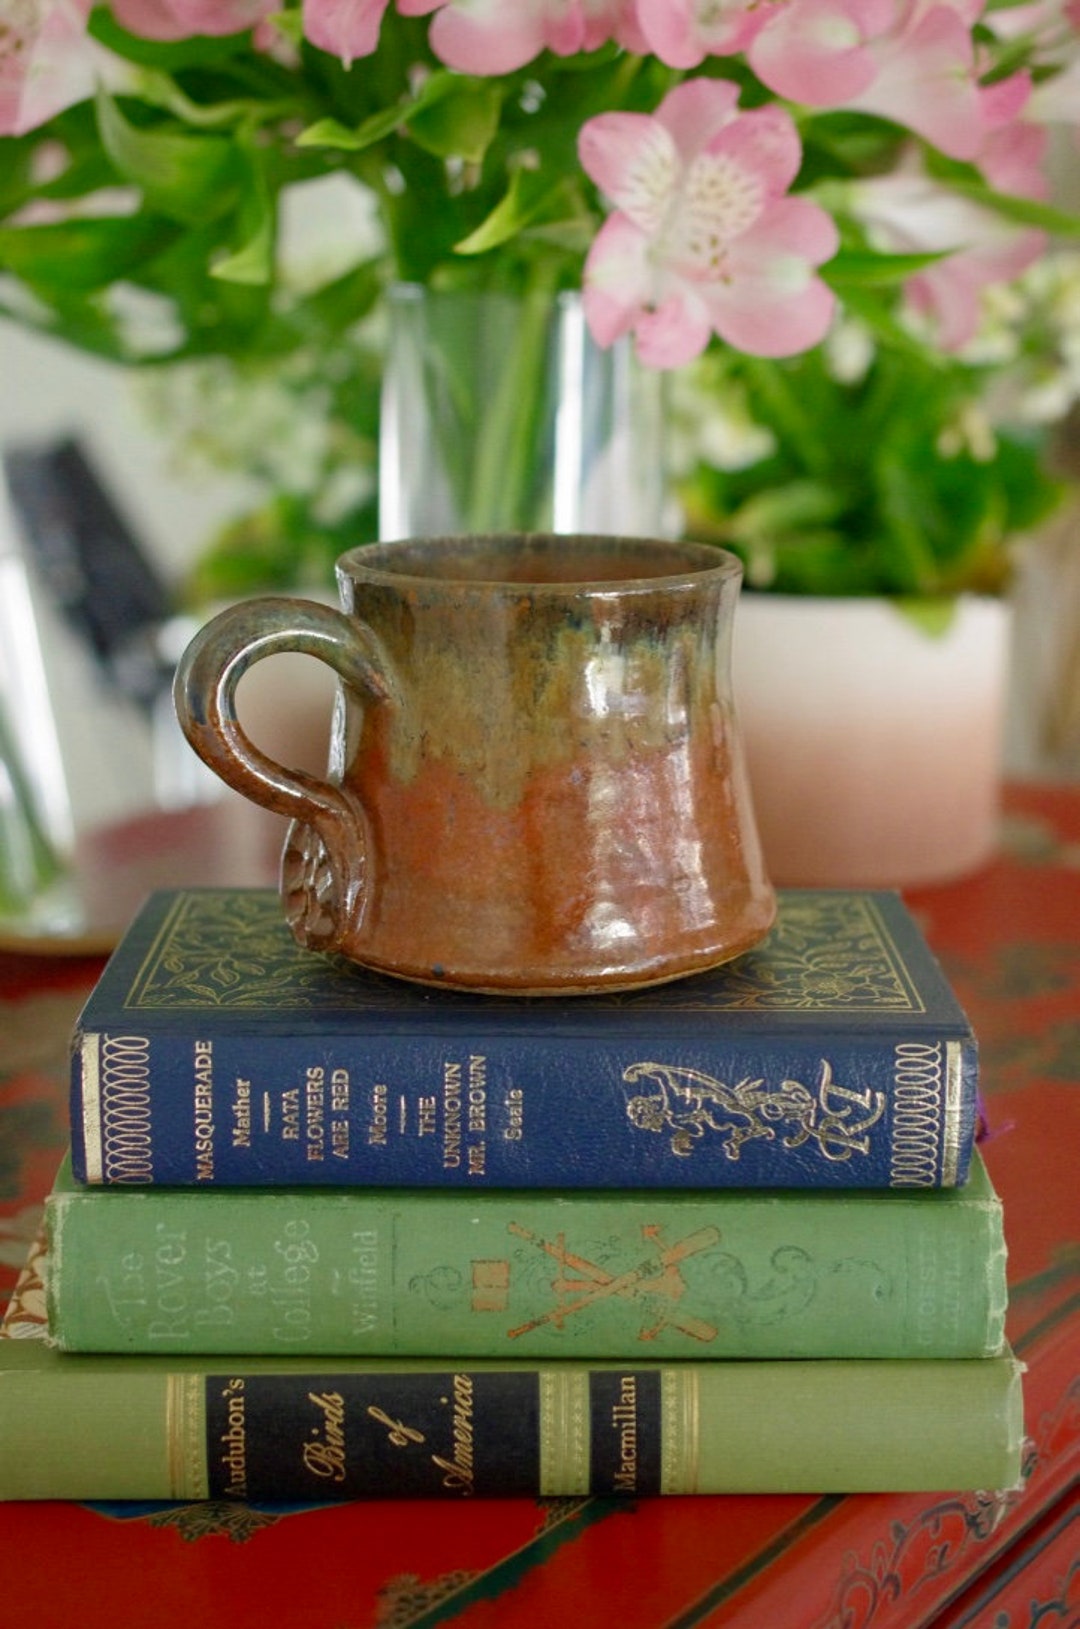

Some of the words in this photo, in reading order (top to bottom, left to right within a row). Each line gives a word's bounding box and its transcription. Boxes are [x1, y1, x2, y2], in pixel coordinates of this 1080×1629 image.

[194, 1040, 215, 1181] MASQUERADE
[232, 1078, 251, 1148] Mather
[282, 1088, 299, 1140] RATA
[307, 1065, 325, 1161] FLOWERS
[332, 1069, 350, 1111] RED
[369, 1084, 387, 1145] Moore
[418, 1096, 436, 1136] THE
[444, 1062, 462, 1168] UNKNOWN
[468, 1055, 486, 1132] BROWN
[332, 1120, 350, 1159] ARE
[468, 1140, 486, 1175] MR.
[149, 1223, 189, 1339] Rover
[196, 1237, 239, 1325] Boys
[250, 1264, 267, 1296] at
[271, 1220, 319, 1341] College
[352, 1230, 378, 1335] Winfield
[221, 1378, 247, 1496] Audubon's
[303, 1392, 346, 1481] Birds
[368, 1406, 425, 1446] of
[432, 1374, 474, 1495] America
[612, 1376, 636, 1491] Macmillan
